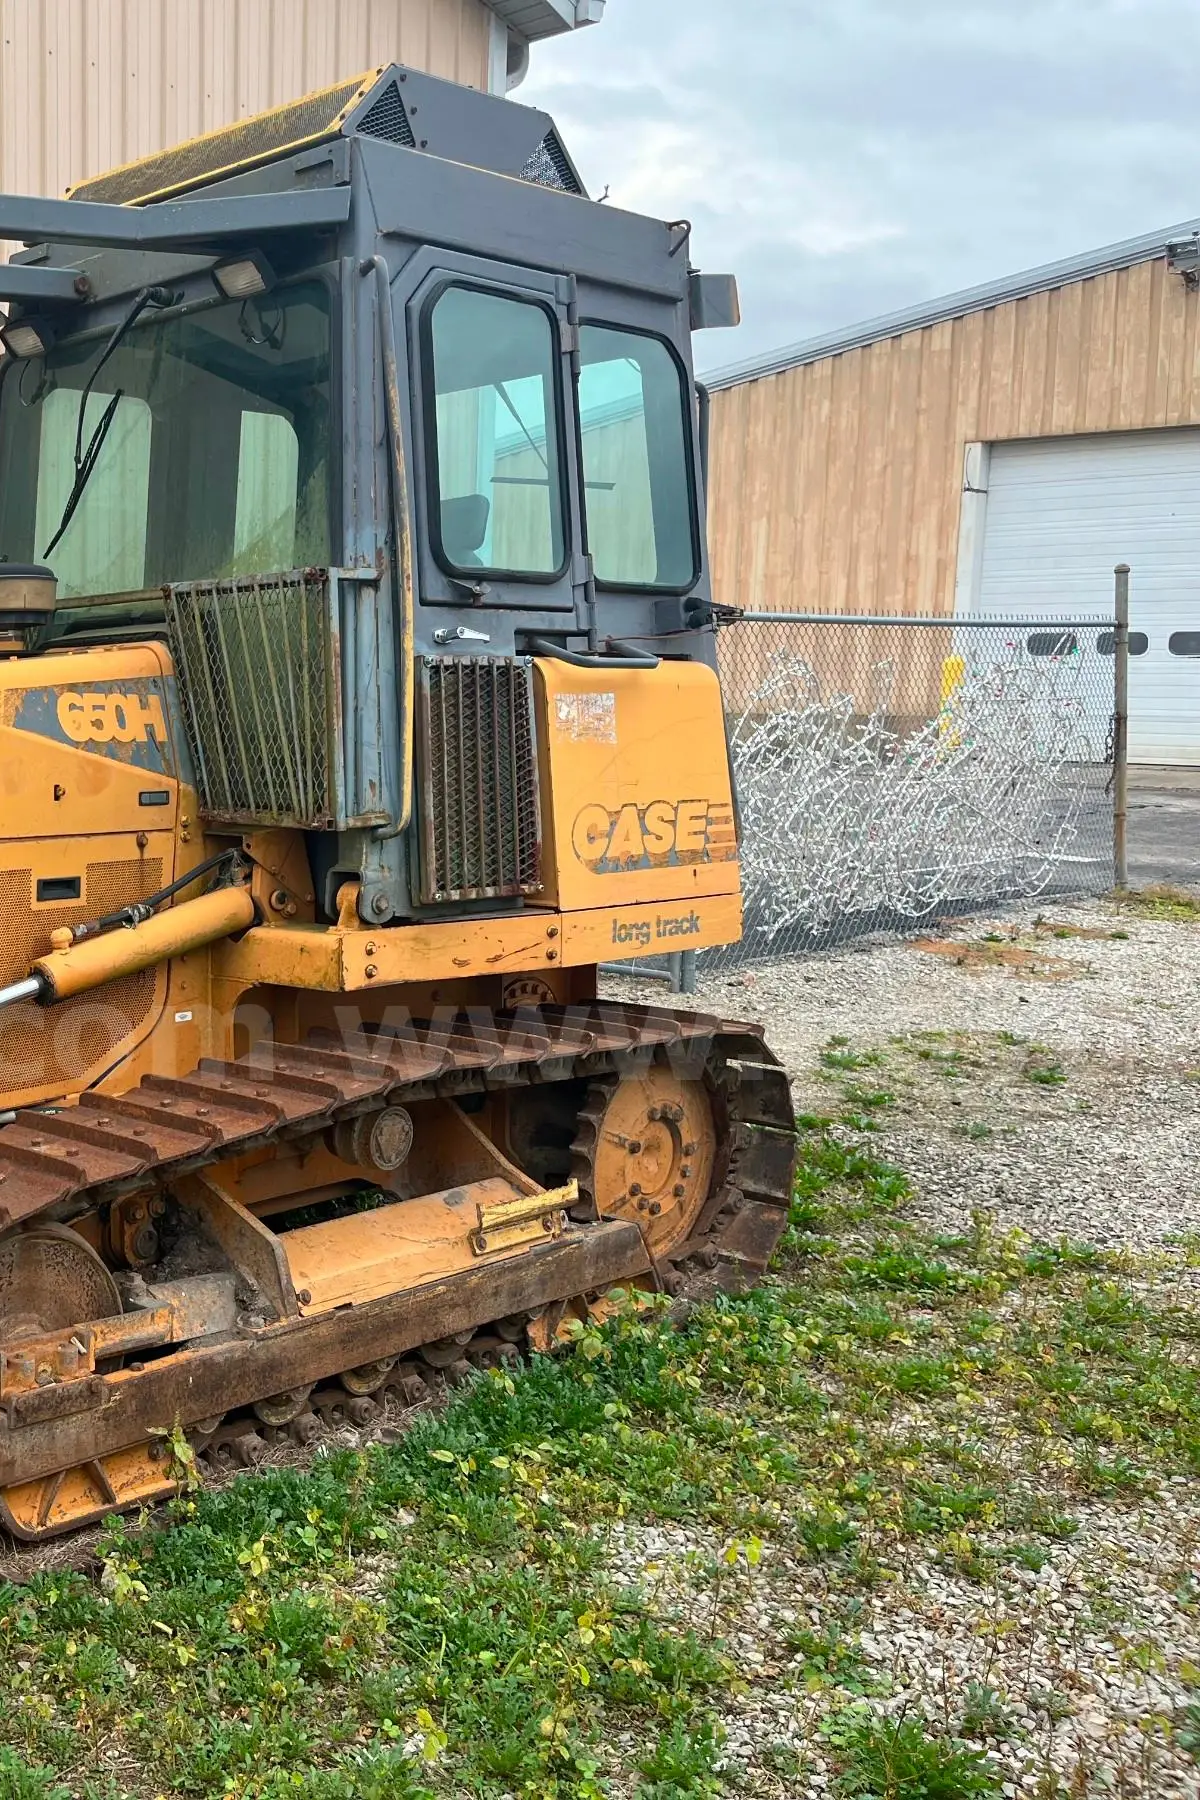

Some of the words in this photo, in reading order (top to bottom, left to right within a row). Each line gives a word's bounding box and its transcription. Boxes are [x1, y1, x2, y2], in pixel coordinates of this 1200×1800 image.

[571, 799, 709, 861] CASE
[611, 918, 651, 946] long
[656, 909, 700, 938] track
